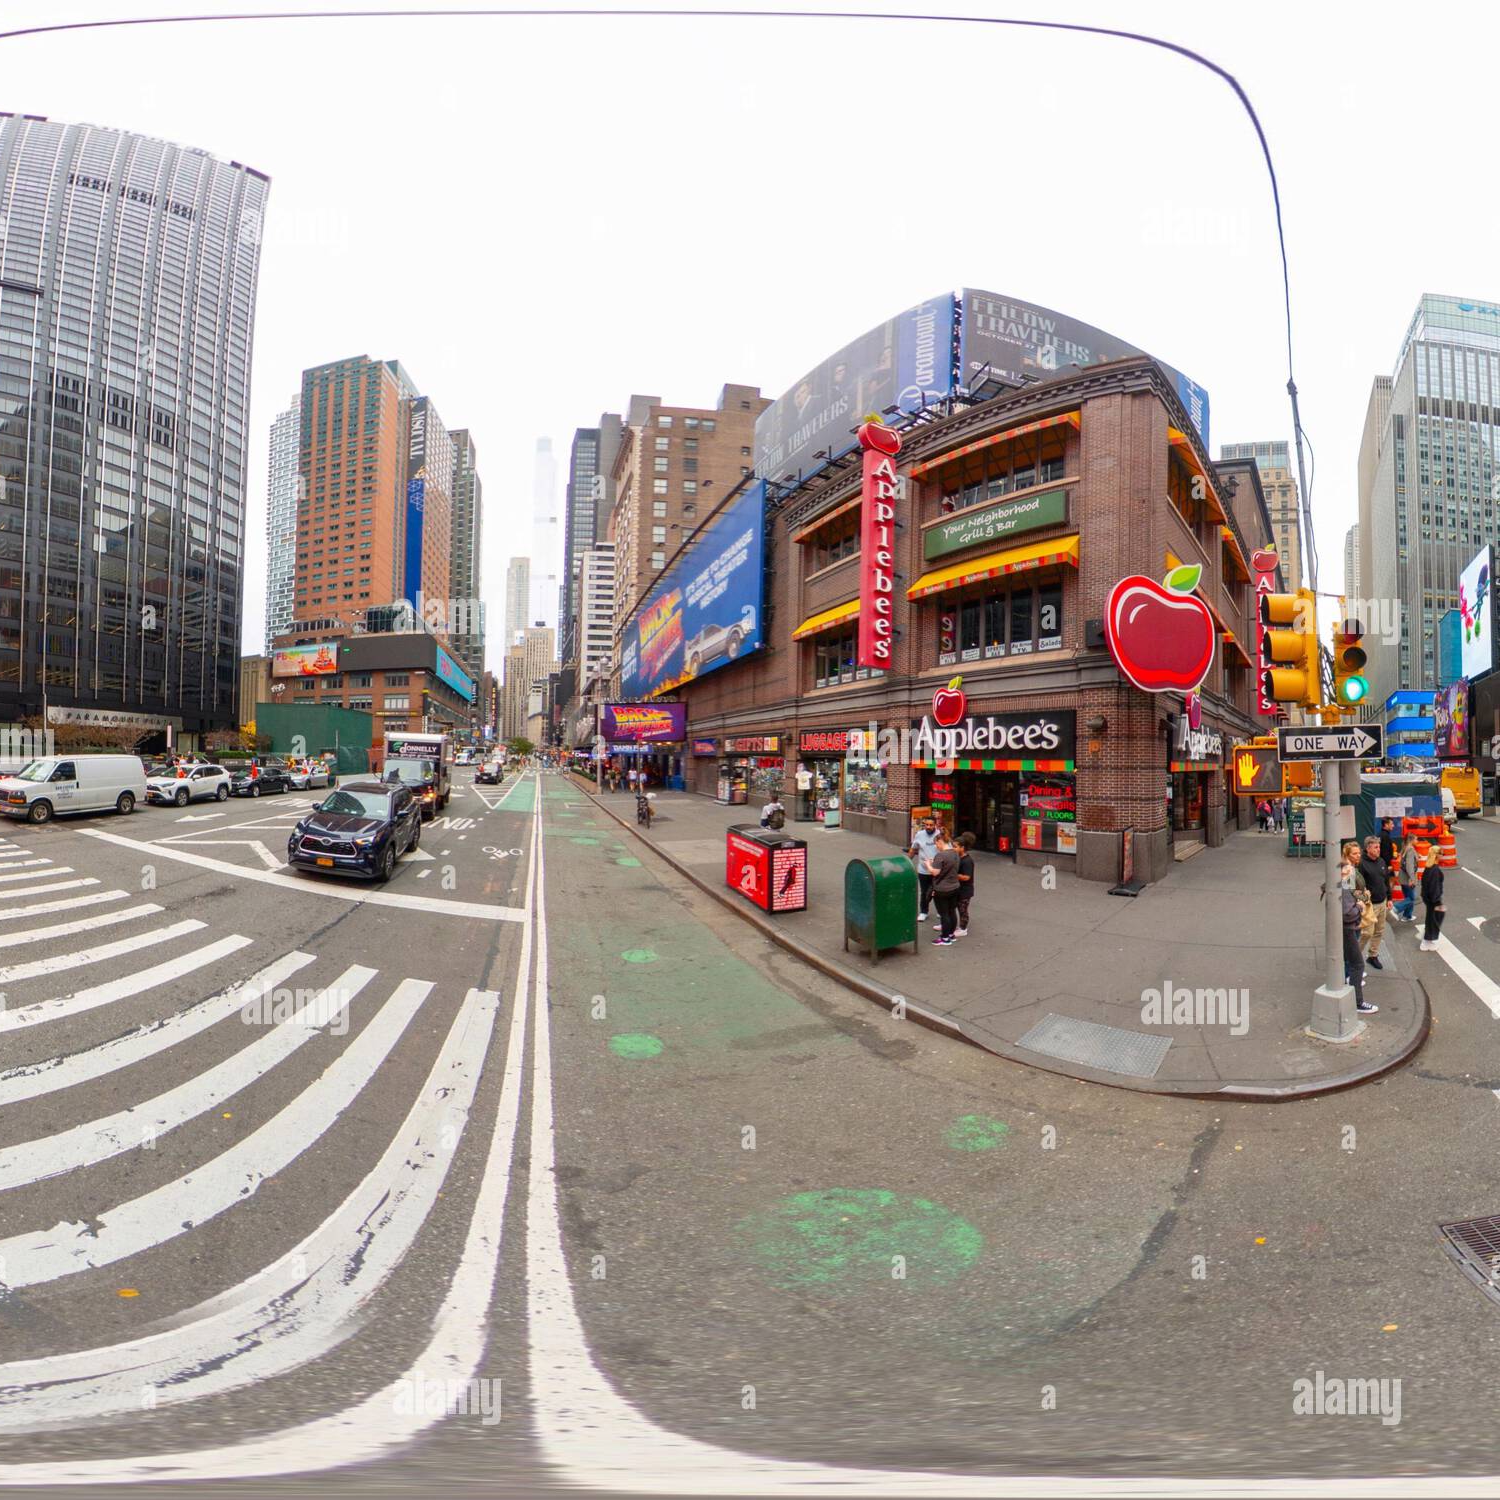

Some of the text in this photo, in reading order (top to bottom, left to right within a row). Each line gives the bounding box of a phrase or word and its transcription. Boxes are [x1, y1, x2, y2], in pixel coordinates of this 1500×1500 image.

[972, 298, 1056, 333] FELLOW
[973, 313, 1090, 362] TRAVELERS
[976, 331, 1022, 346] OCTOBER
[788, 395, 848, 453] TRAVELERS
[943, 498, 1040, 539] Your Neighborhood
[959, 531, 984, 543] Grill
[996, 519, 1018, 532] Bar
[611, 706, 673, 723] BACK
[734, 736, 764, 751] GIFTS
[800, 733, 848, 751] LUGGAGE
[914, 714, 1060, 759] Applebee's
[1294, 736, 1367, 750] ONE WAY
[1029, 785, 1073, 798] Dining &
[1046, 810, 1075, 820] FLOORS
